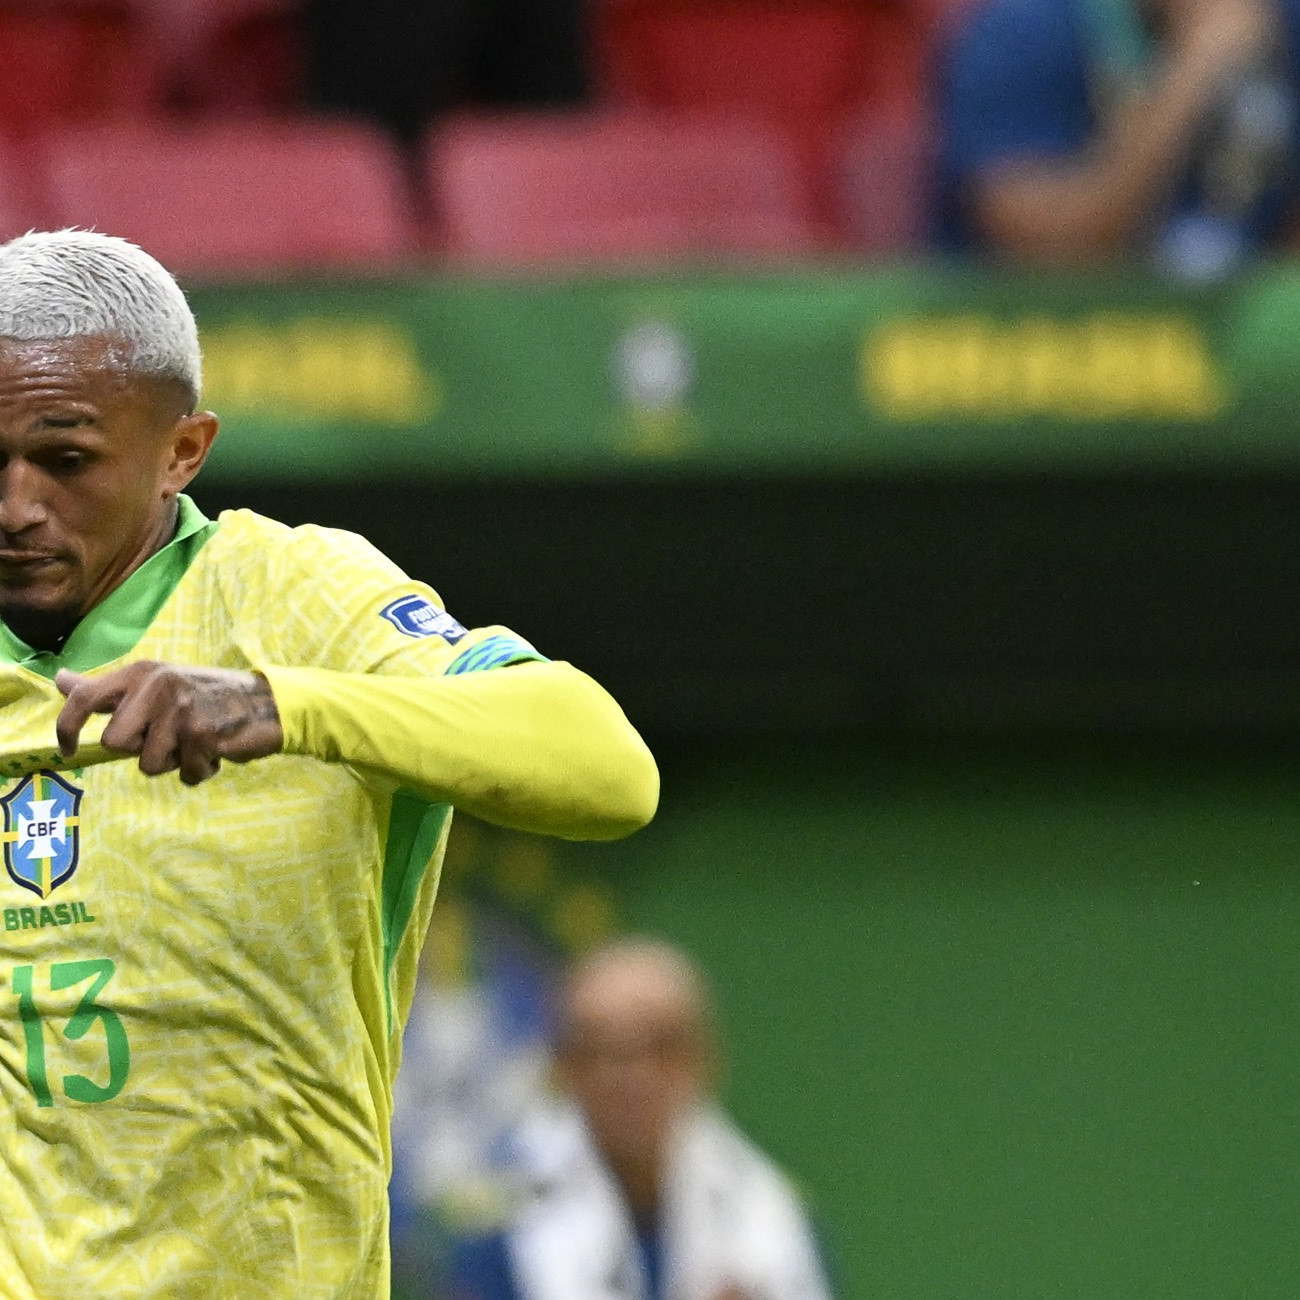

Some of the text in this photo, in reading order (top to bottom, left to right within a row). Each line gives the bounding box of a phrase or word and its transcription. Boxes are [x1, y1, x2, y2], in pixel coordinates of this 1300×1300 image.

[26, 820, 59, 839] CBF
[3, 901, 96, 932] BRASIL
[11, 957, 132, 1108] 13
